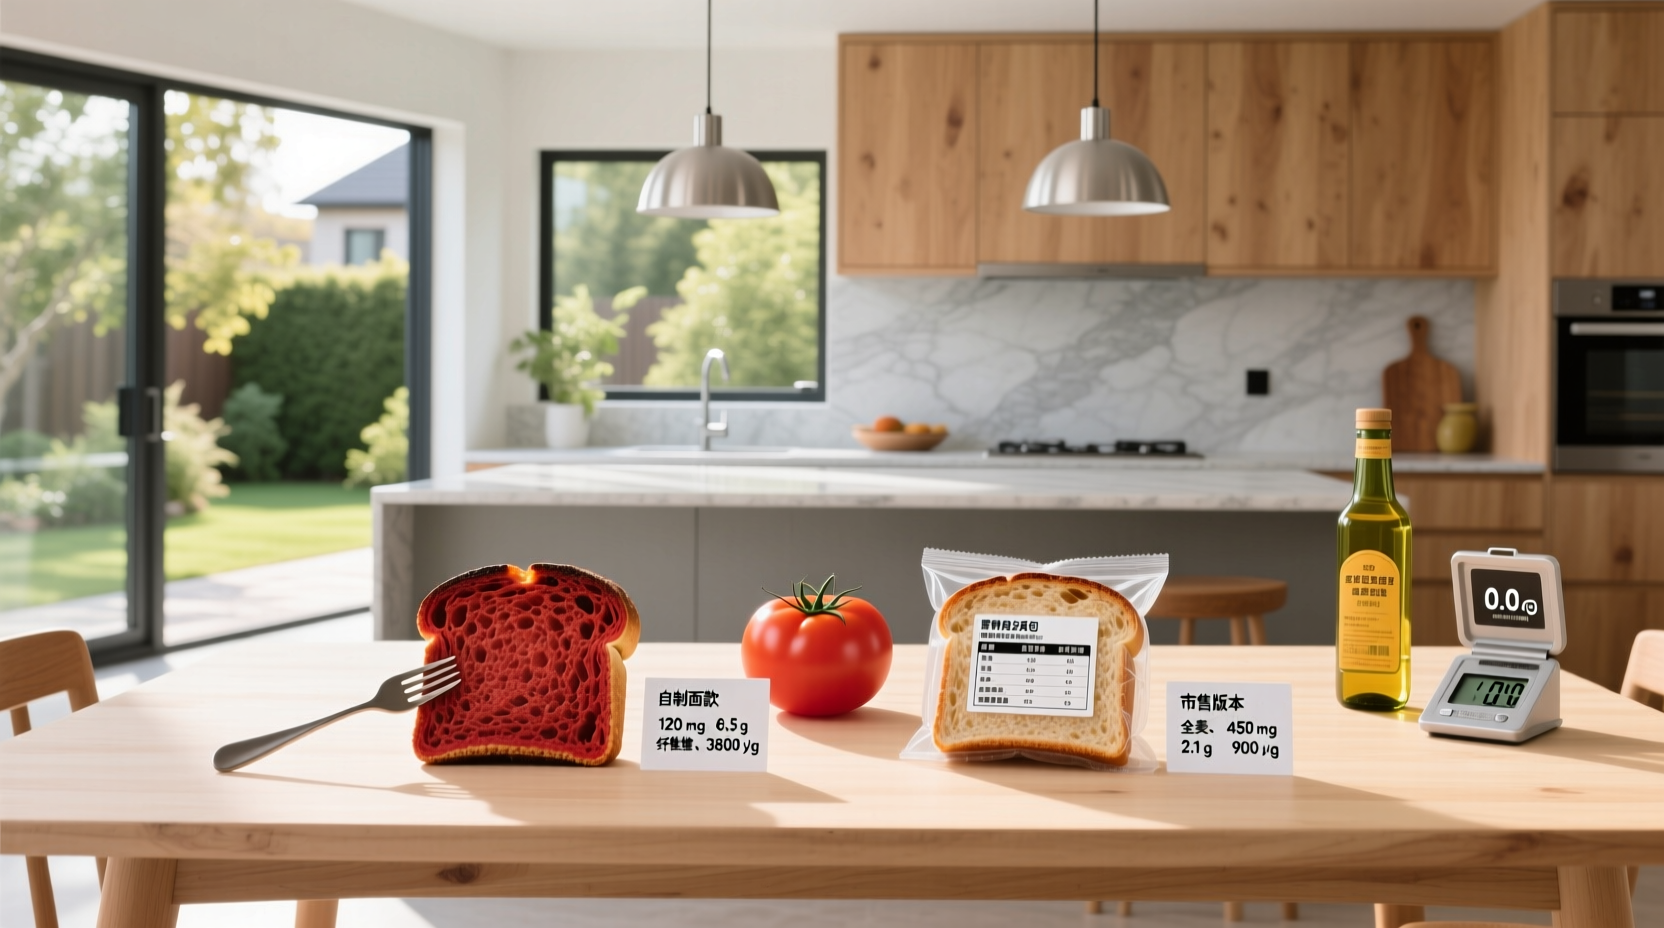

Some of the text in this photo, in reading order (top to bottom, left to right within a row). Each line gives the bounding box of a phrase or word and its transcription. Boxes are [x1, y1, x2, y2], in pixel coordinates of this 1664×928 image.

[1180, 693, 1245, 712] 市售版本
[659, 717, 683, 731] 120
[686, 721, 706, 735] mg
[740, 721, 748, 735] g
[1227, 720, 1254, 735] 450
[1257, 725, 1277, 739] mg
[706, 737, 740, 752] 3800
[1181, 739, 1200, 754] 2.1
[1203, 744, 1213, 758] g
[1232, 740, 1259, 754] 900
